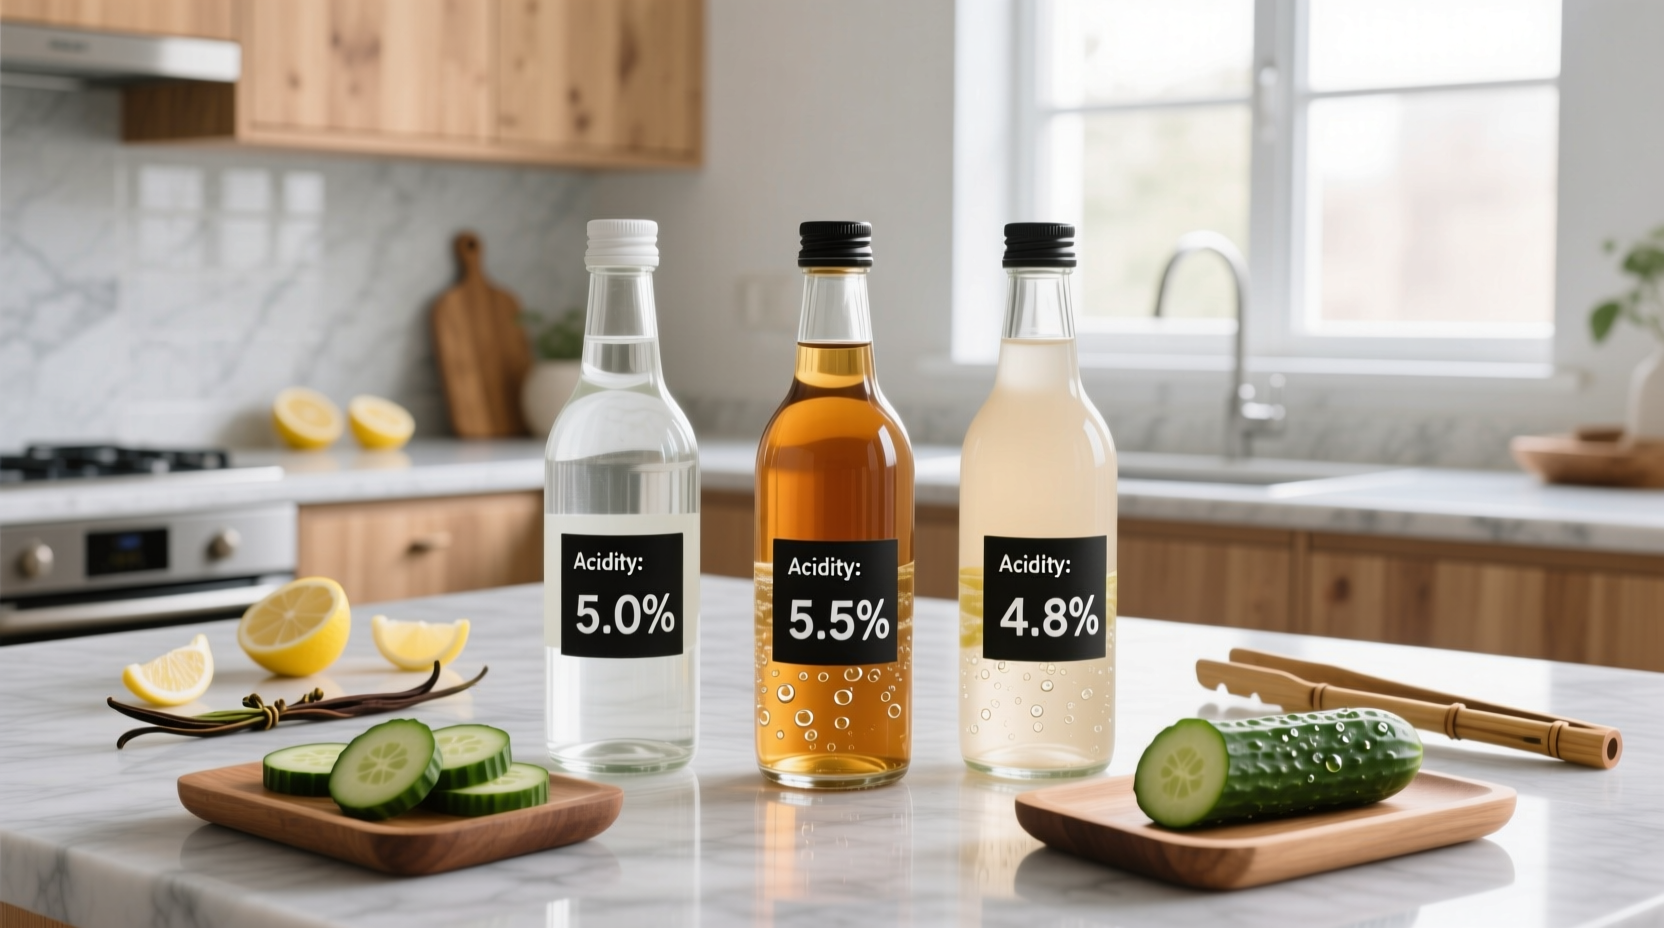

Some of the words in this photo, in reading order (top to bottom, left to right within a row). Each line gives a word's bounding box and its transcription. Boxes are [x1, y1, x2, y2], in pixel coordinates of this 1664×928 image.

[574, 552, 642, 575] Acidity:
[788, 557, 860, 581] Acidity:
[999, 554, 1070, 578] Acidity:
[577, 593, 674, 634] 5.0%
[790, 598, 889, 640] 5.5%
[1000, 594, 1099, 637] 4.8%
